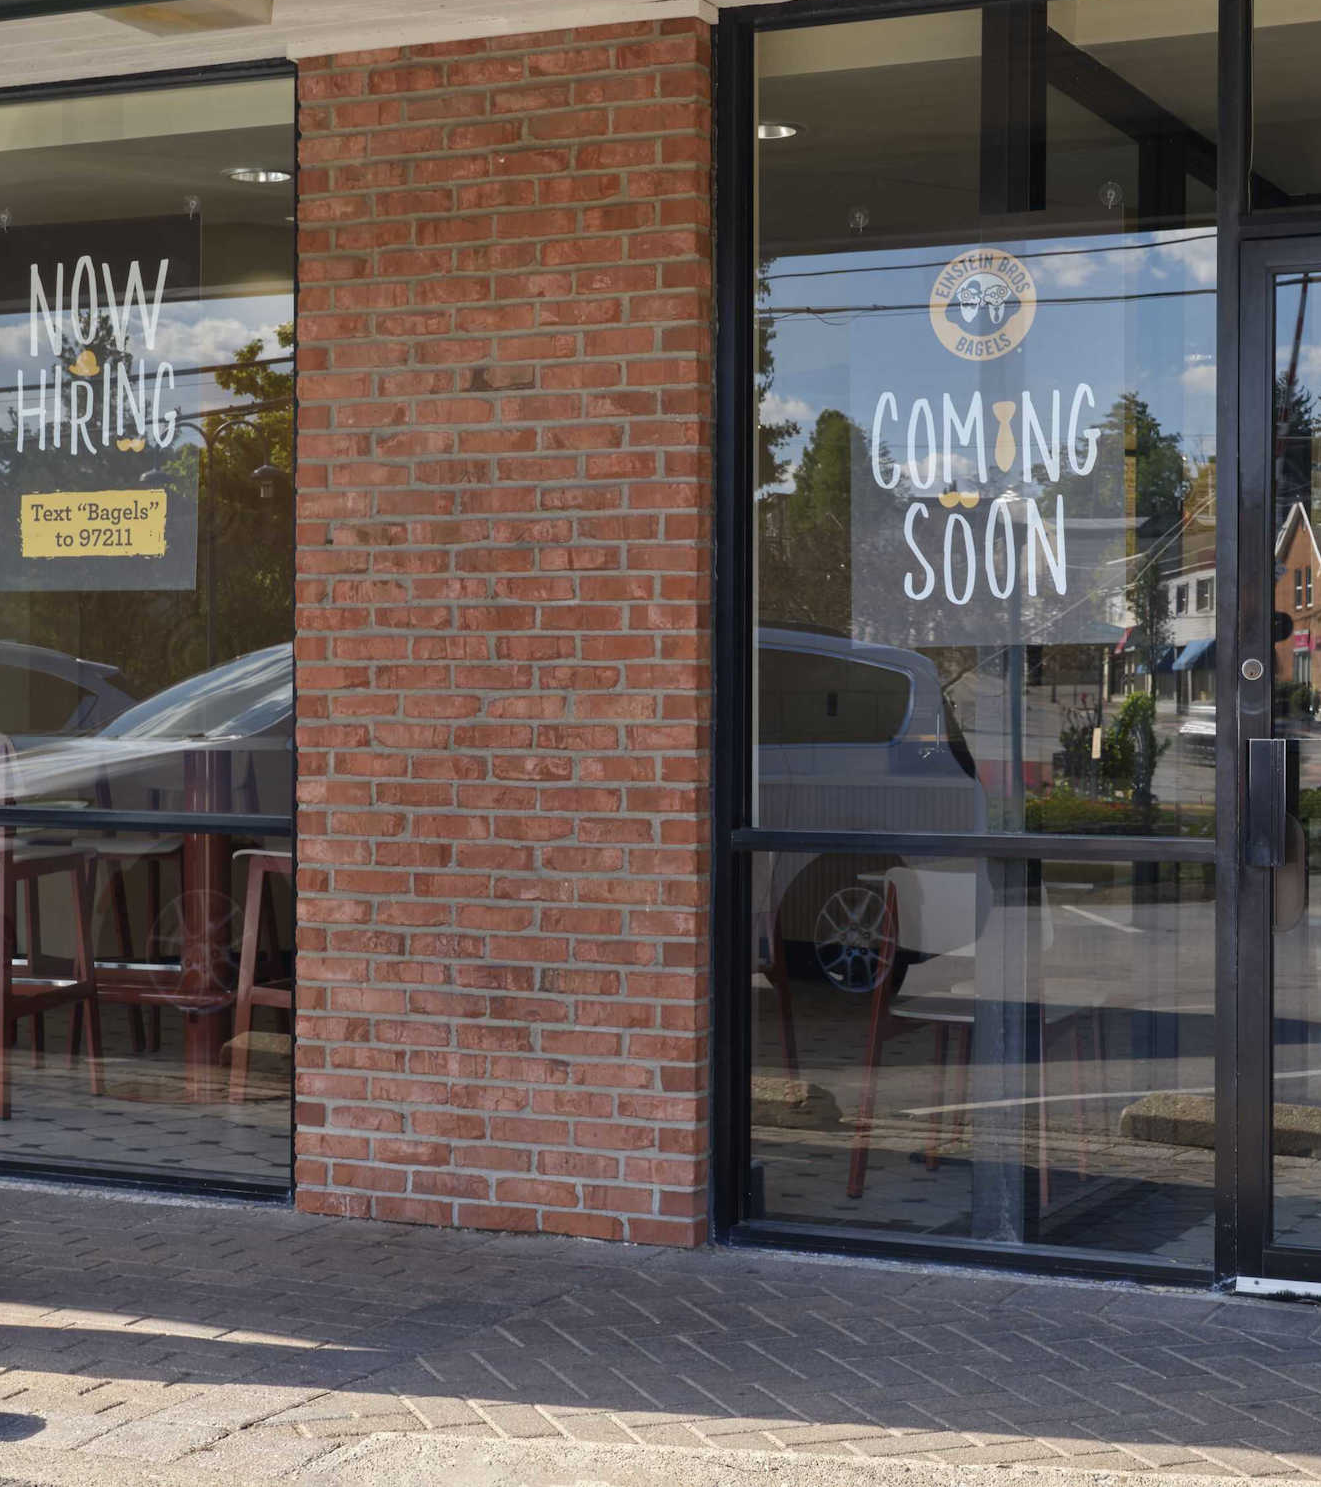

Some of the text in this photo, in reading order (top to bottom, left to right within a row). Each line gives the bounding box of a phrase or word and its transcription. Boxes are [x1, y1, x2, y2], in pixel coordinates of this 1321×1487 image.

[935, 253, 1031, 299] EINSTEIN BROS
[30, 255, 169, 357] NOW
[955, 333, 1012, 357] BAGELS
[16, 359, 177, 456] HIRING
[31, 504, 72, 522] Text
[55, 528, 134, 548] to 97211
[903, 494, 1068, 605] SOON
